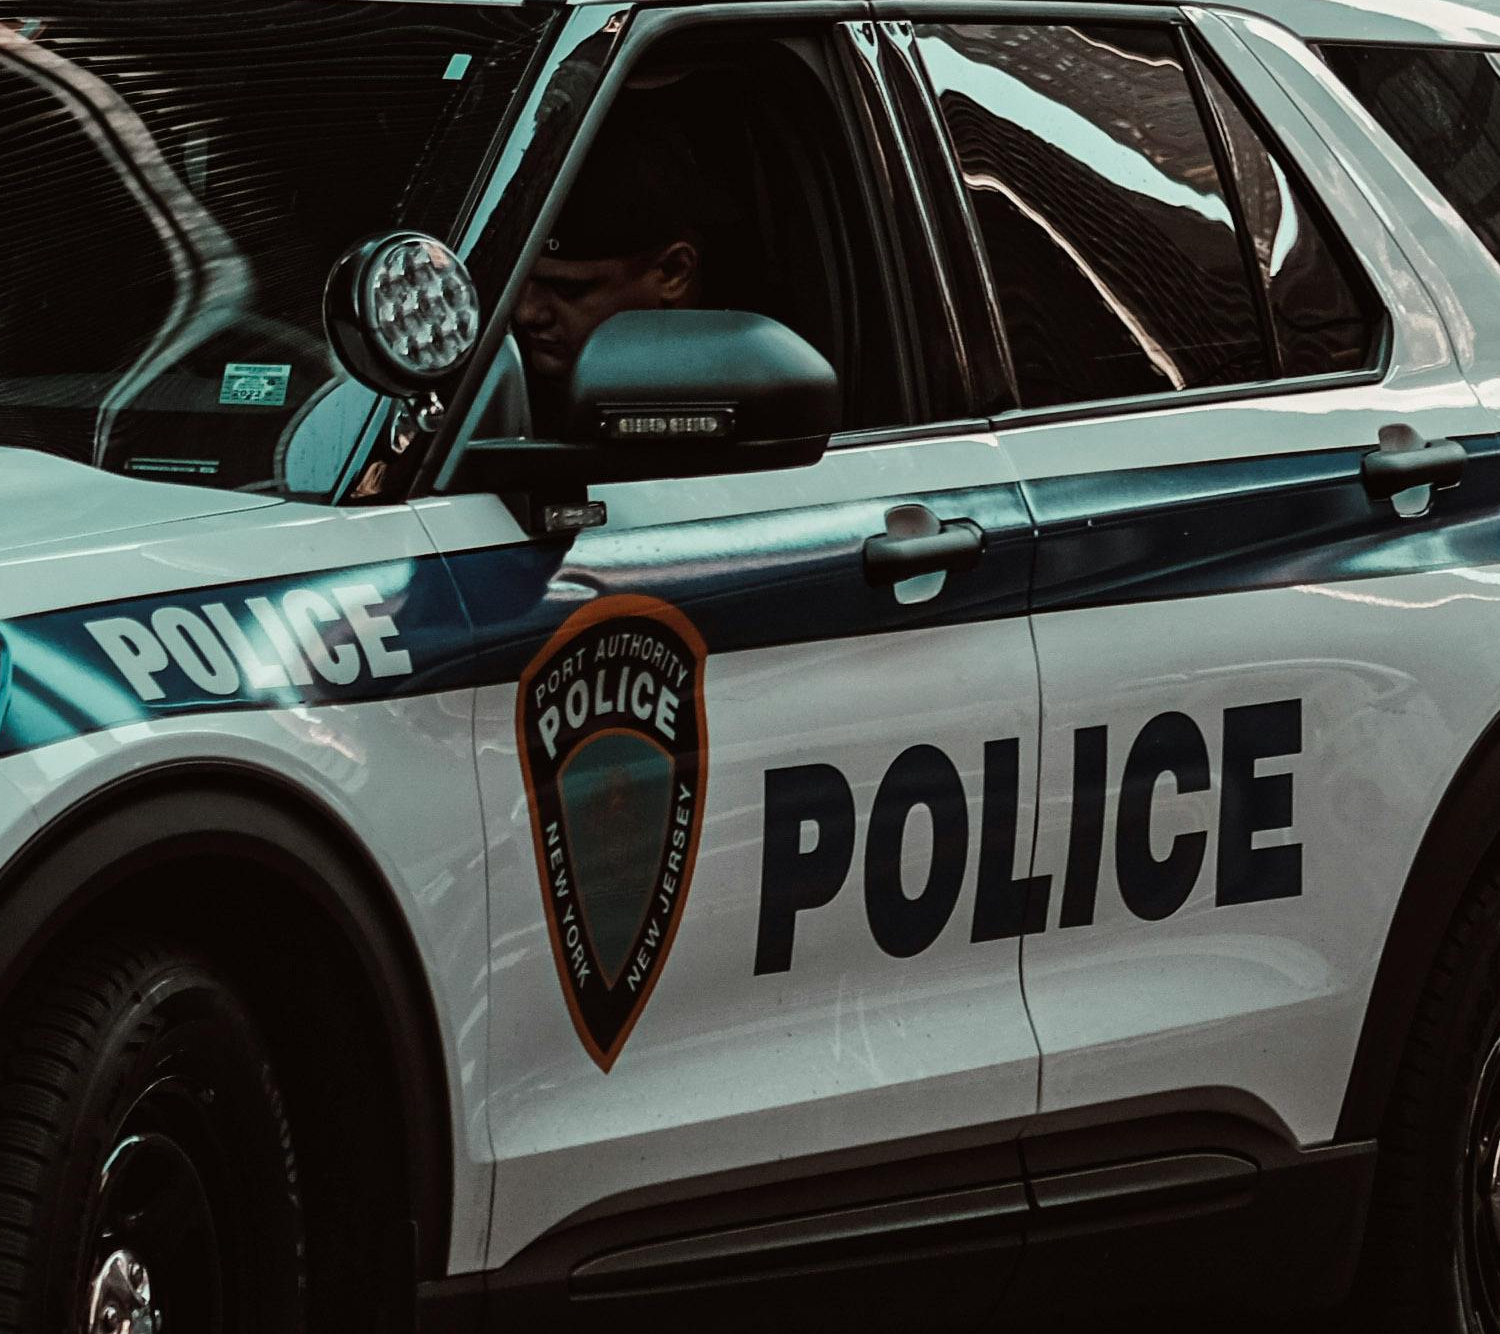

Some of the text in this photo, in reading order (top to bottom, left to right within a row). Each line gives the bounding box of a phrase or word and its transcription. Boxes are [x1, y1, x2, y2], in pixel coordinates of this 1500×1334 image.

[84, 584, 413, 701] POLICE
[534, 633, 690, 709] PORT AUTHORITY
[537, 665, 681, 761] POLICE
[545, 821, 592, 989] NEW YORK
[626, 782, 693, 992] NEW JERSEY
[753, 698, 1302, 976] POLICE
